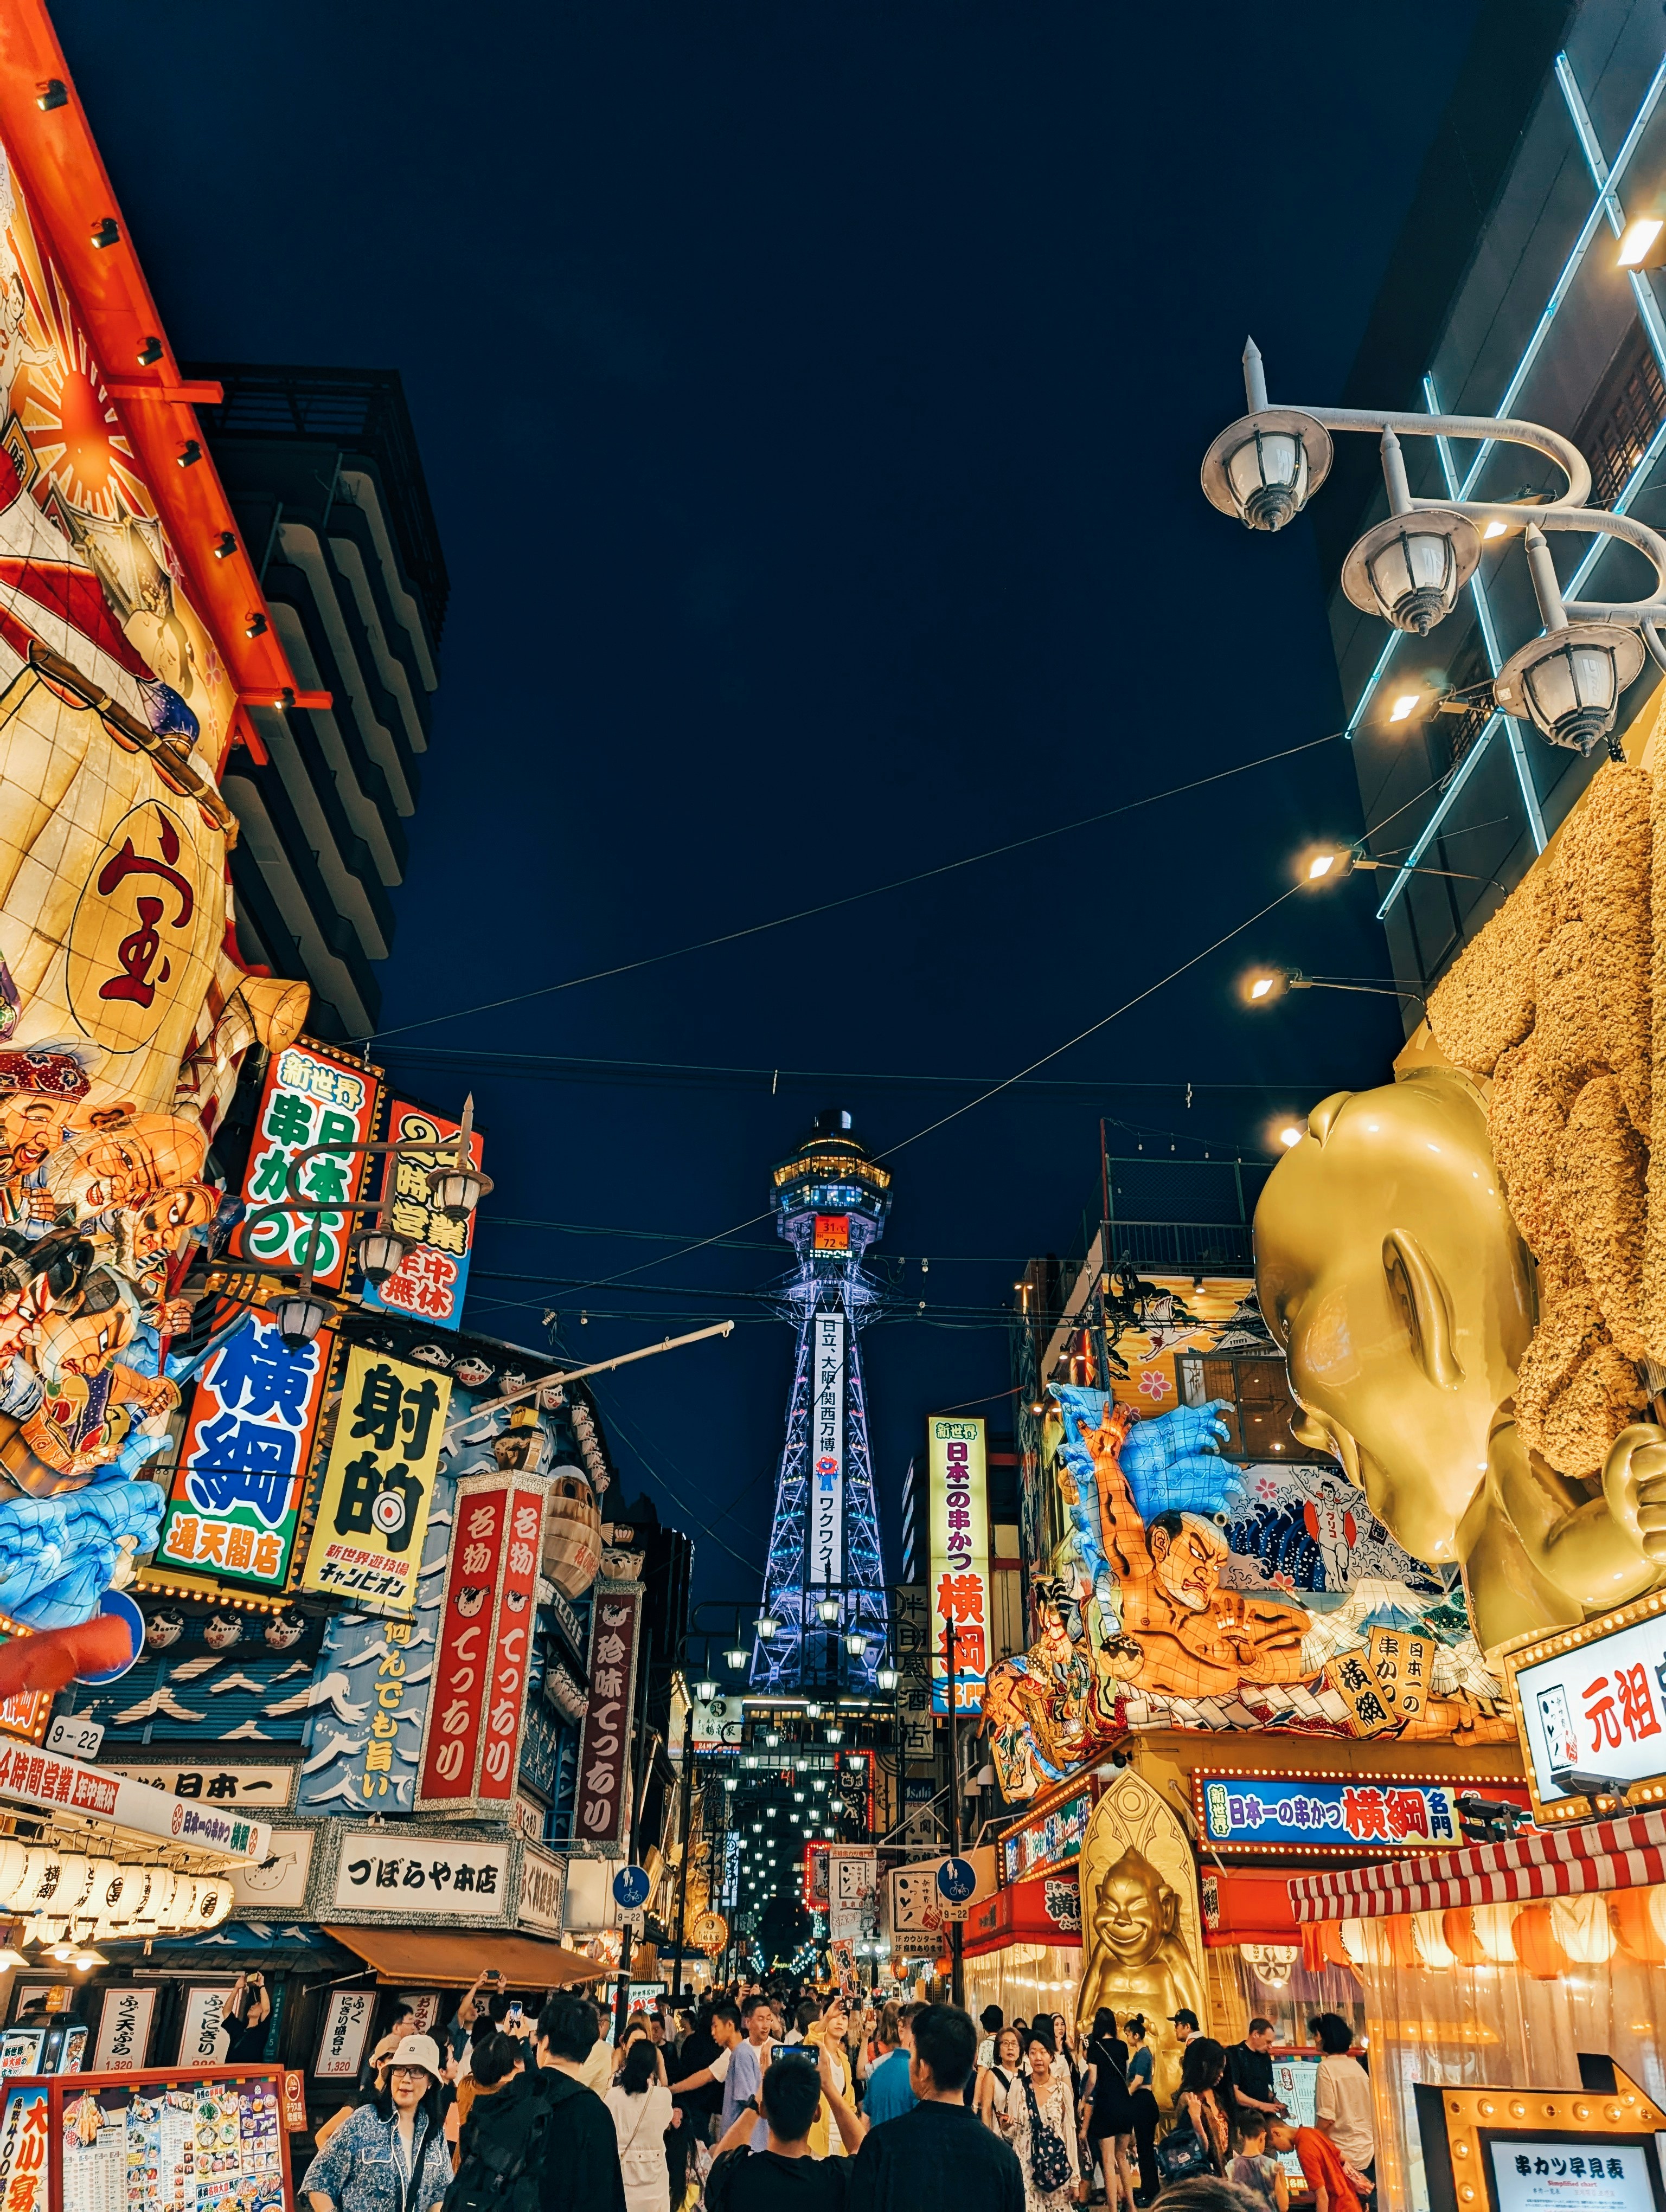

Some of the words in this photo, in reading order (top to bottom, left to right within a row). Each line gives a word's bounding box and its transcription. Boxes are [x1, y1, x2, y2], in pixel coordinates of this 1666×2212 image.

[282, 1054, 362, 1111] 新世界
[810, 1249, 853, 1258] HITACHI
[823, 1223, 835, 1232] 31
[823, 1238, 836, 1248] 72
[385, 1275, 449, 1314] 無休
[190, 1320, 316, 1523] 横綱
[936, 1423, 977, 1441] 新世界
[334, 1364, 440, 1552] 射的
[946, 1442, 972, 1571] 日本一の串かつ
[1326, 1512, 1337, 1539] グリコ
[168, 1516, 281, 1576] 通天閣店
[325, 1544, 409, 1576] 新世界遊技場
[462, 1505, 496, 1576] 名物
[510, 1506, 538, 1576] 名物
[320, 1562, 408, 1597] チャンピオン
[937, 1573, 985, 1675] 横綱
[1376, 1636, 1399, 1703] 串かつ
[1403, 1642, 1423, 1712] 日本一の
[362, 1617, 411, 1799] 何んでも旨い
[435, 1625, 482, 1782] てっちり
[486, 1627, 527, 1782] てっちり
[1582, 1651, 1666, 1753] 元祖
[583, 1635, 626, 1832] 珍味てっちり
[75, 1774, 116, 1811] 年中無休
[175, 1772, 273, 1798] 日本一
[1210, 1786, 1228, 1835] 新世界
[1229, 1797, 1341, 1827] 日本一の串かつ
[1343, 1788, 1429, 1839] 横綱
[1427, 1792, 1453, 1838] 名門
[348, 1857, 498, 1894] づぼらや本店
[618, 1913, 641, 1922] 9-22
[895, 1935, 902, 1943] 1F
[944, 1909, 967, 1919] 9-22
[111, 1995, 139, 2055] ふぐ天ぷら
[198, 1994, 223, 2055] ふぐにぎり
[330, 1996, 353, 2056] にぎり盛合せ
[350, 1996, 364, 2024] ふぐ
[413, 1997, 431, 2035] おみや
[327, 2061, 351, 2072] 1,320
[1514, 2155, 1625, 2179] 串カツ早見表
